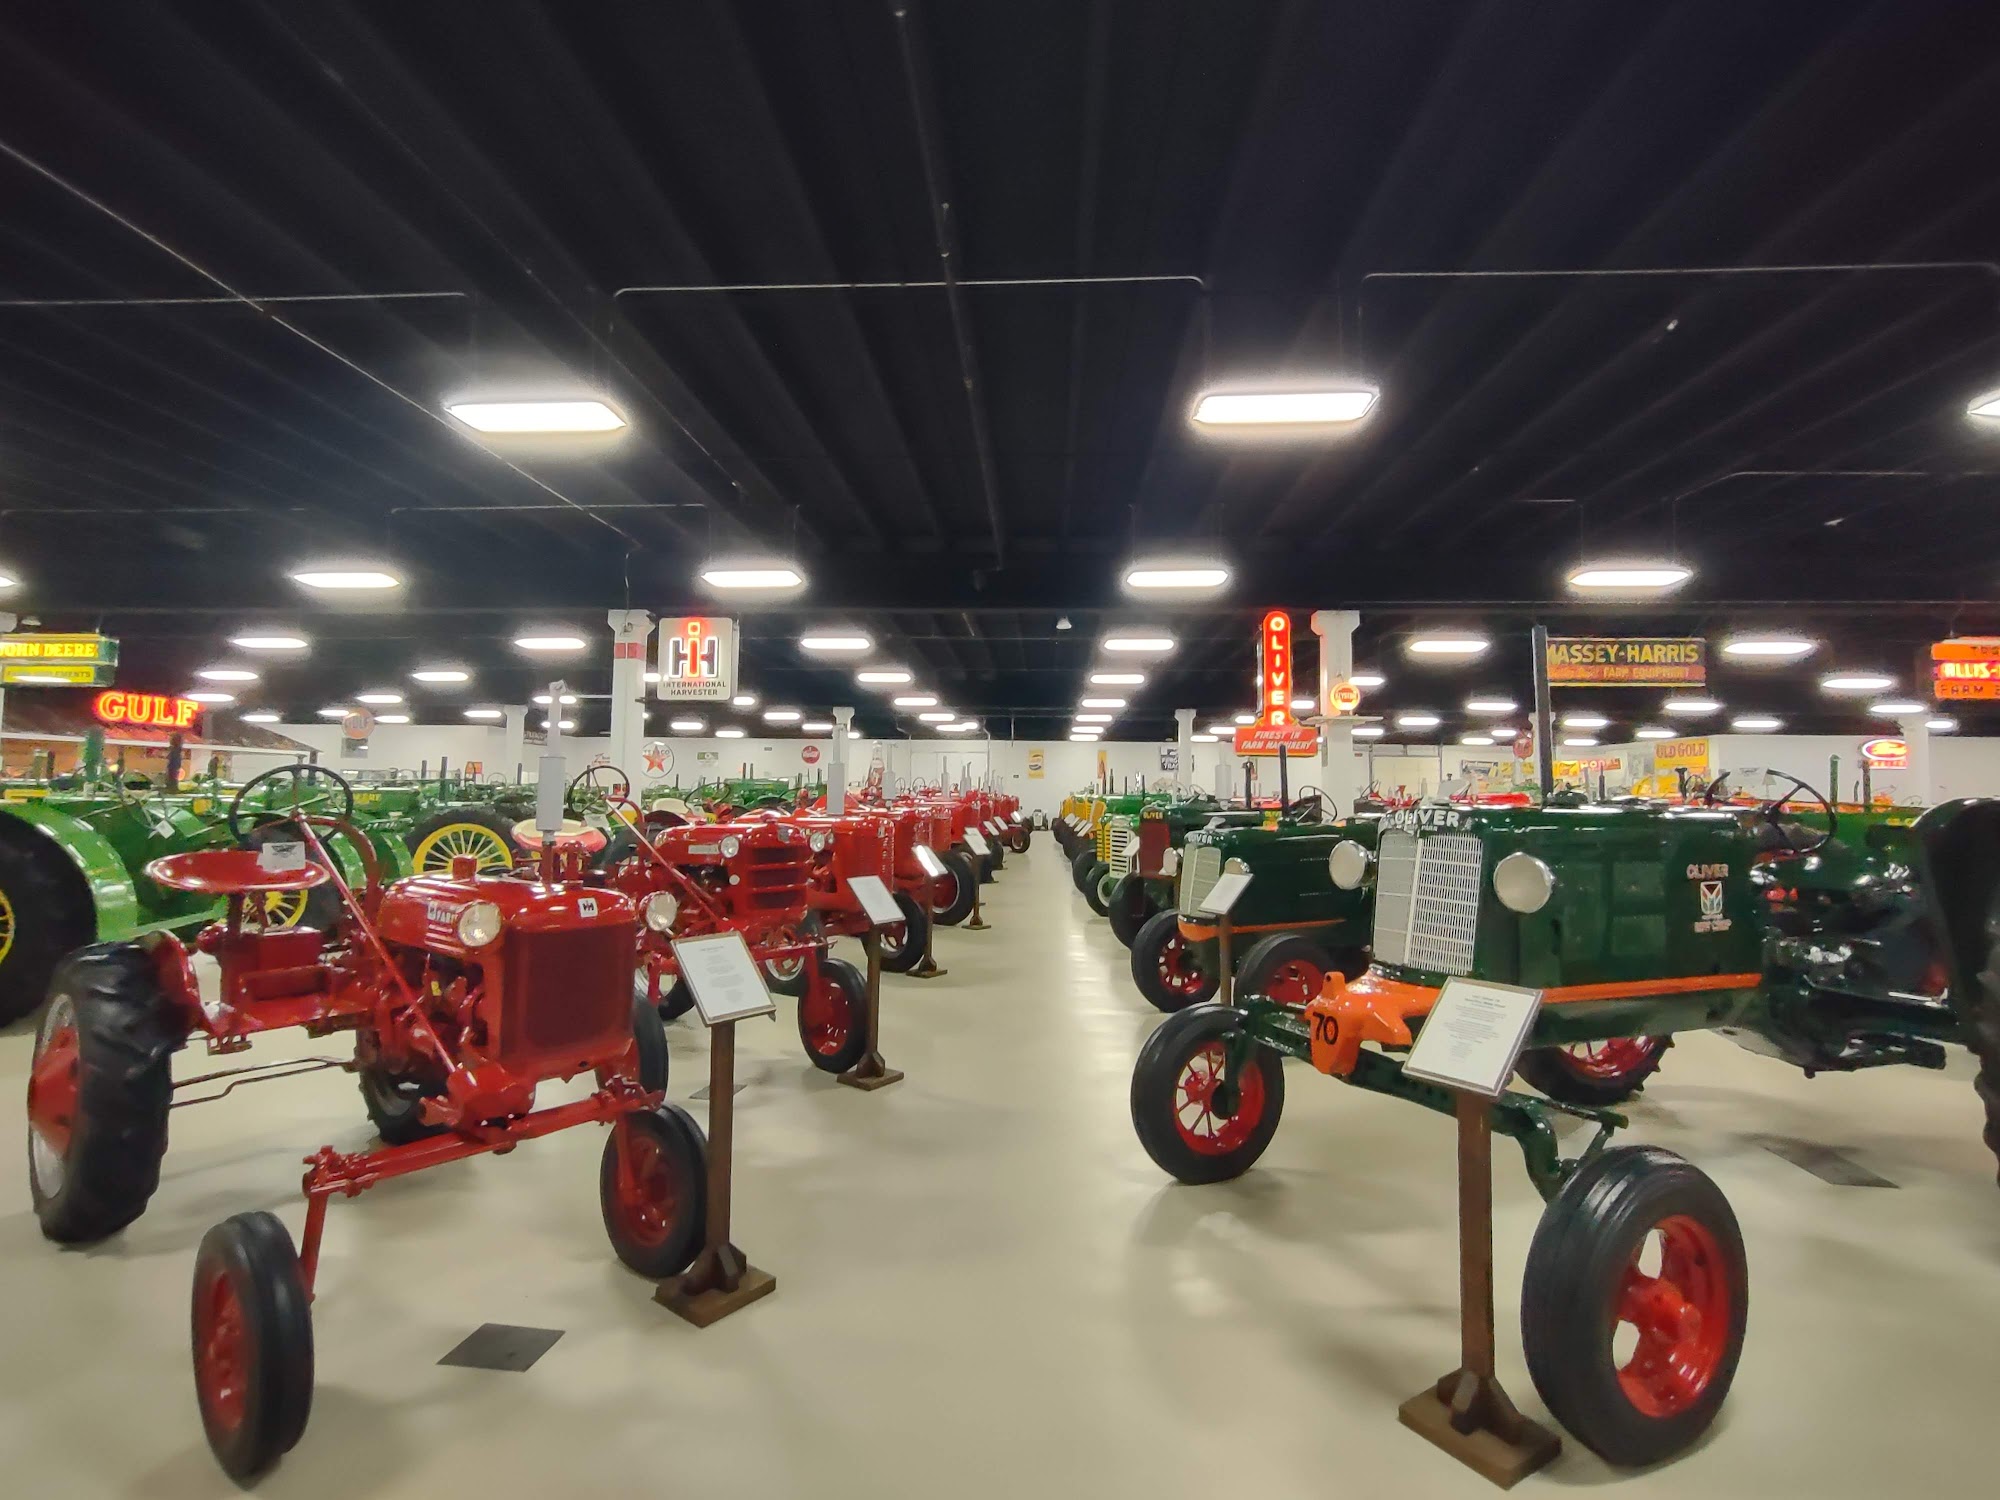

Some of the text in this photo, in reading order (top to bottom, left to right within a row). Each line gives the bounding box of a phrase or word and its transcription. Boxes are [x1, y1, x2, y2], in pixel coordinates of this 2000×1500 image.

[44, 643, 95, 657] DEERE
[1270, 616, 1286, 727] OLIVER
[1941, 685, 1983, 693] FARM
[99, 691, 199, 726] GULF
[1254, 730, 1286, 739] FINEST
[1241, 740, 1264, 750] FARM
[1678, 742, 1706, 757] GOLD
[1395, 809, 1461, 828] OLIVER
[1686, 864, 1729, 879] OLIVER
[1311, 1012, 1339, 1046] 70
